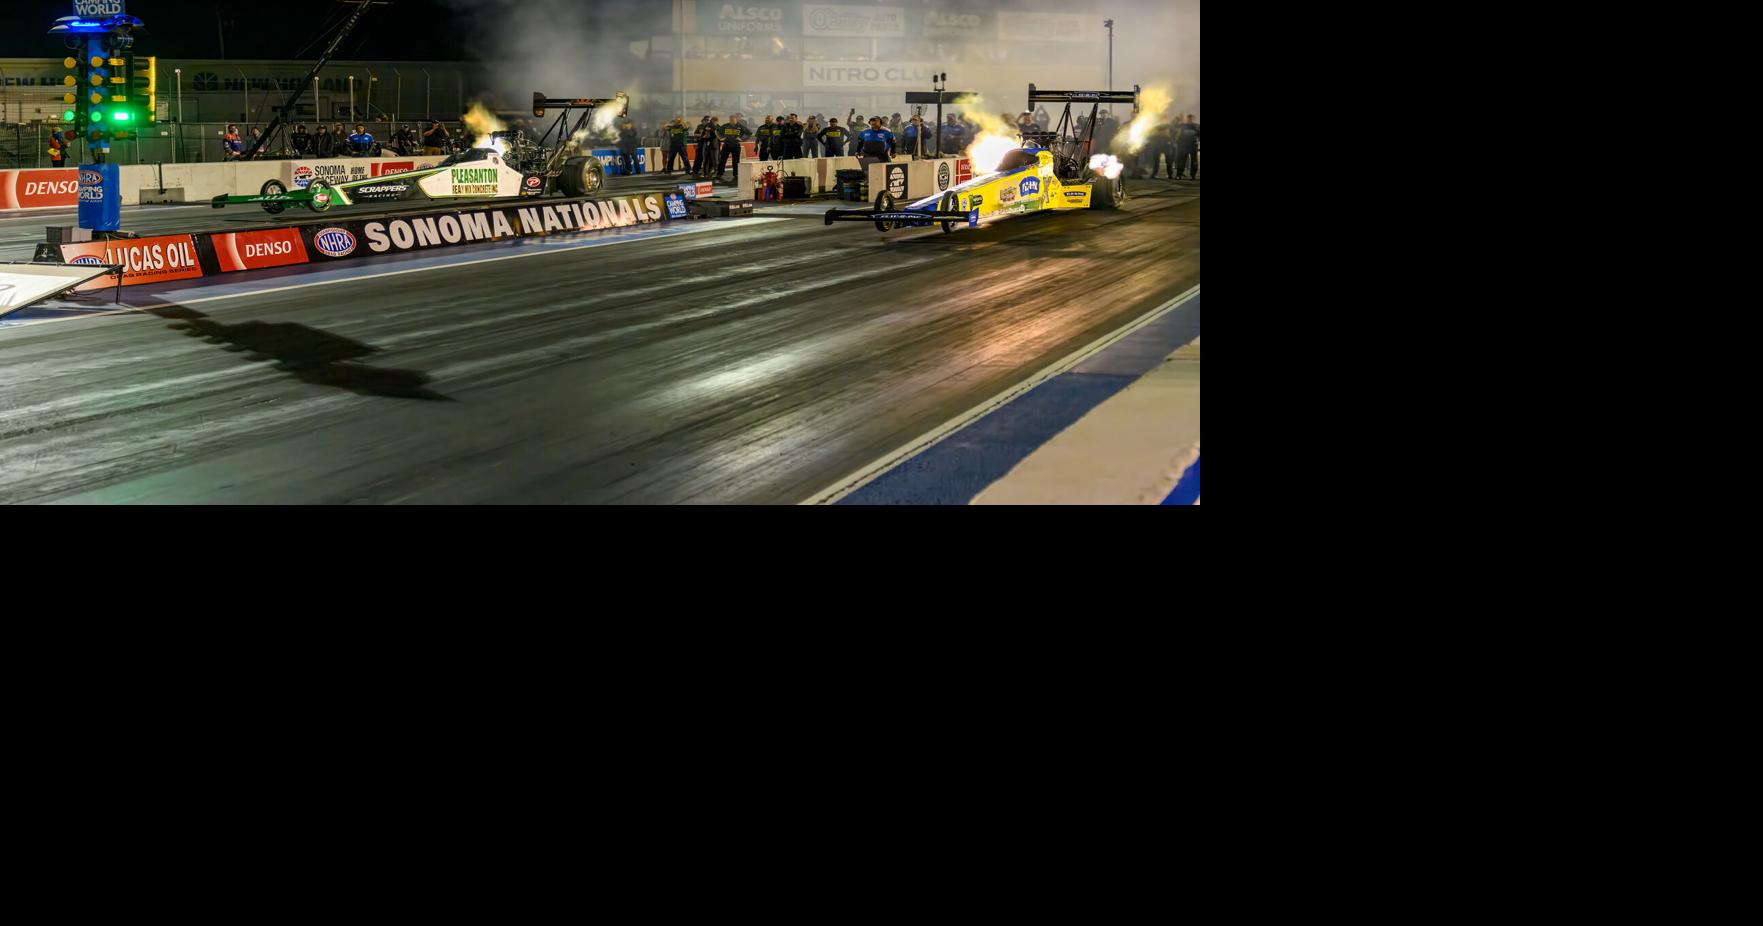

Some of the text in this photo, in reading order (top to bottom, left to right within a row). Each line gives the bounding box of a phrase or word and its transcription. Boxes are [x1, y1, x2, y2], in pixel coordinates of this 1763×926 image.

[75, 4, 121, 15] WORLD
[720, 4, 783, 20] ALSCO
[809, 67, 879, 81] NITRO
[314, 164, 346, 176] SONOMA
[451, 168, 498, 184] PLEASANTON
[25, 180, 79, 196] DENSO
[364, 195, 662, 253] SONOMA NATIONALS
[245, 241, 292, 258] DENSO
[320, 232, 351, 252] NHRA
[106, 242, 195, 272] LUCAS OIL
[136, 269, 168, 277] RACING
